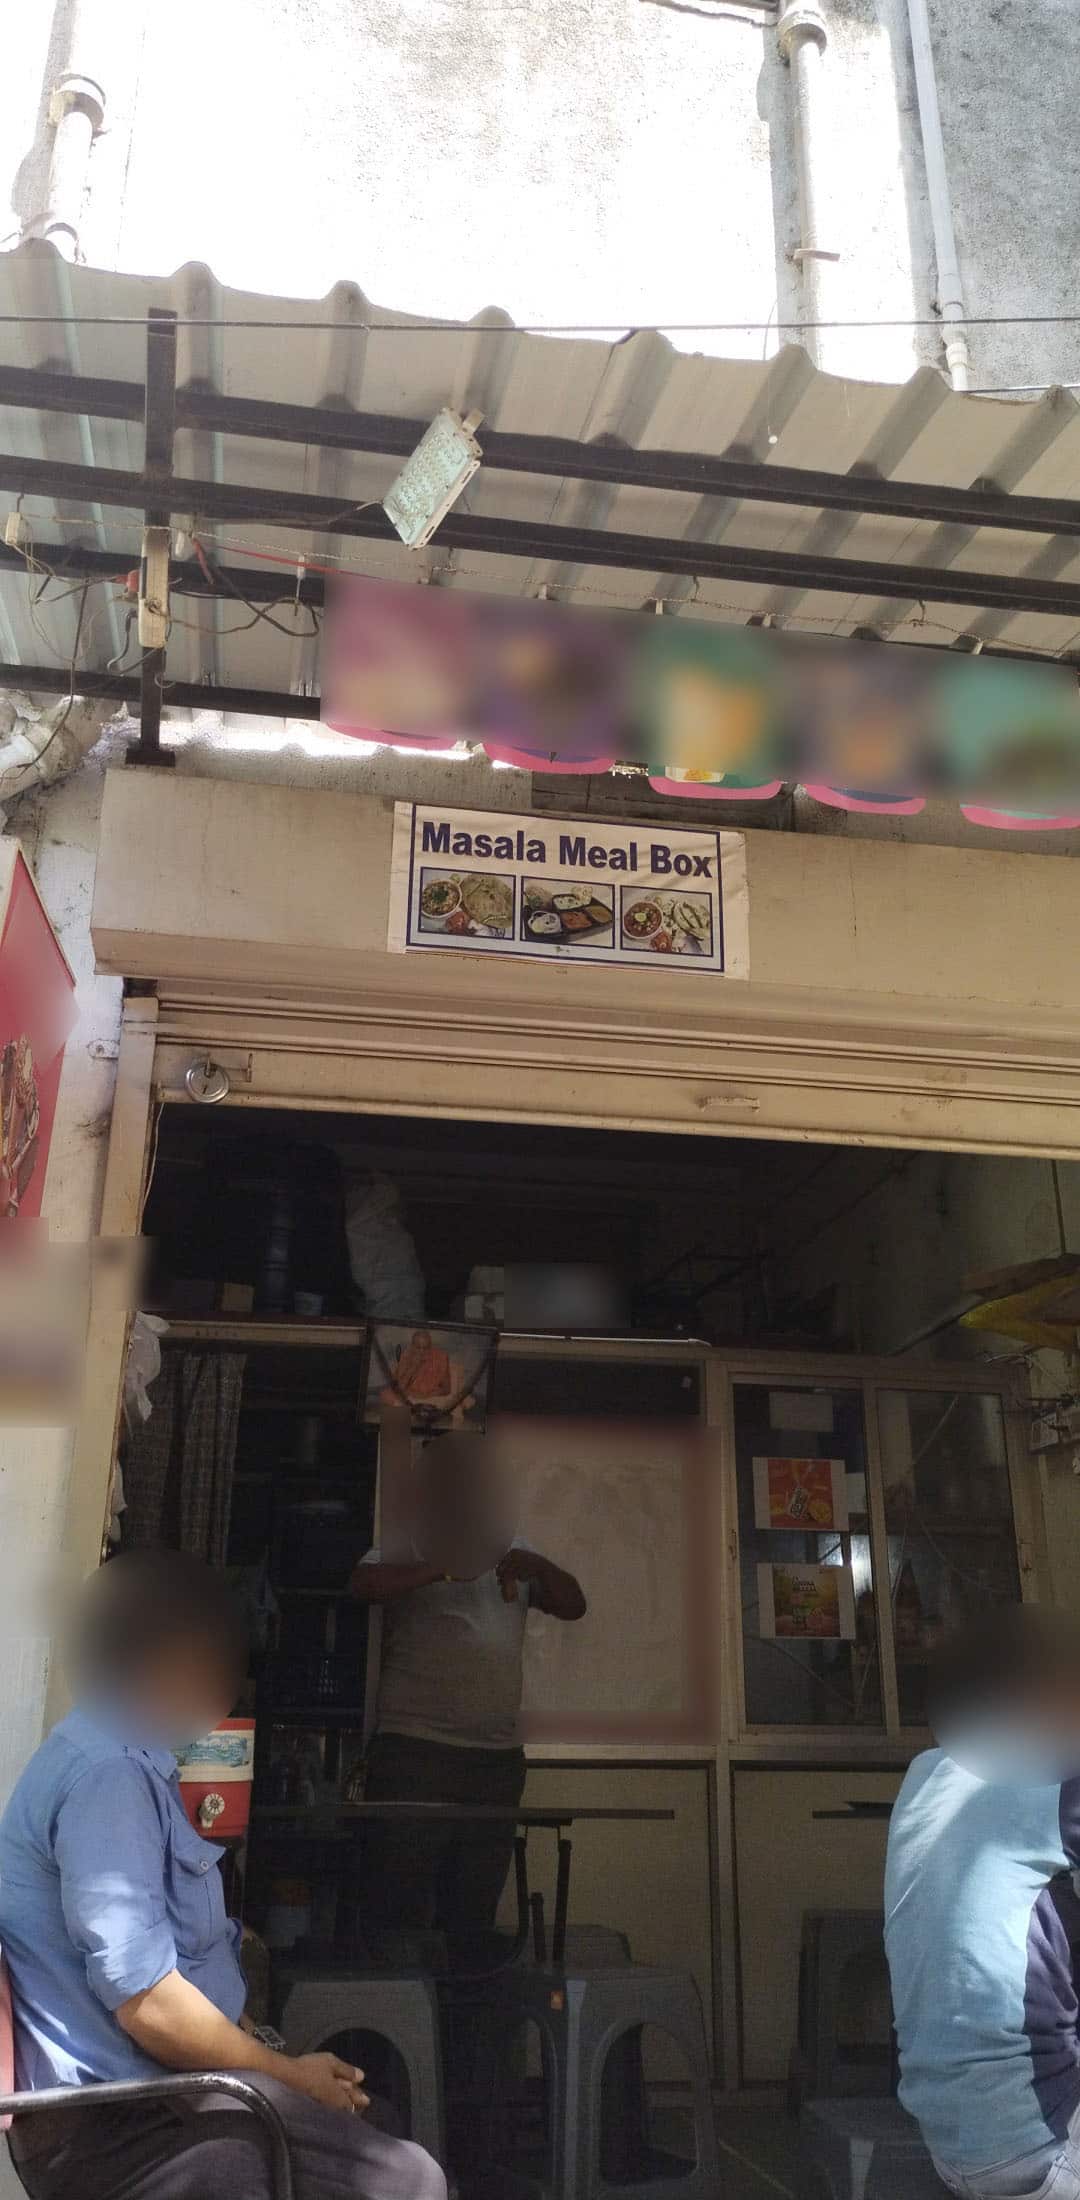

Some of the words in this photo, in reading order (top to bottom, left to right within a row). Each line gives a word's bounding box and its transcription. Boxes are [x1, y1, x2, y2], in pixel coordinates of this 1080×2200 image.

[422, 821, 546, 863] Masala
[559, 836, 638, 871] Meal
[650, 844, 712, 878] Box
